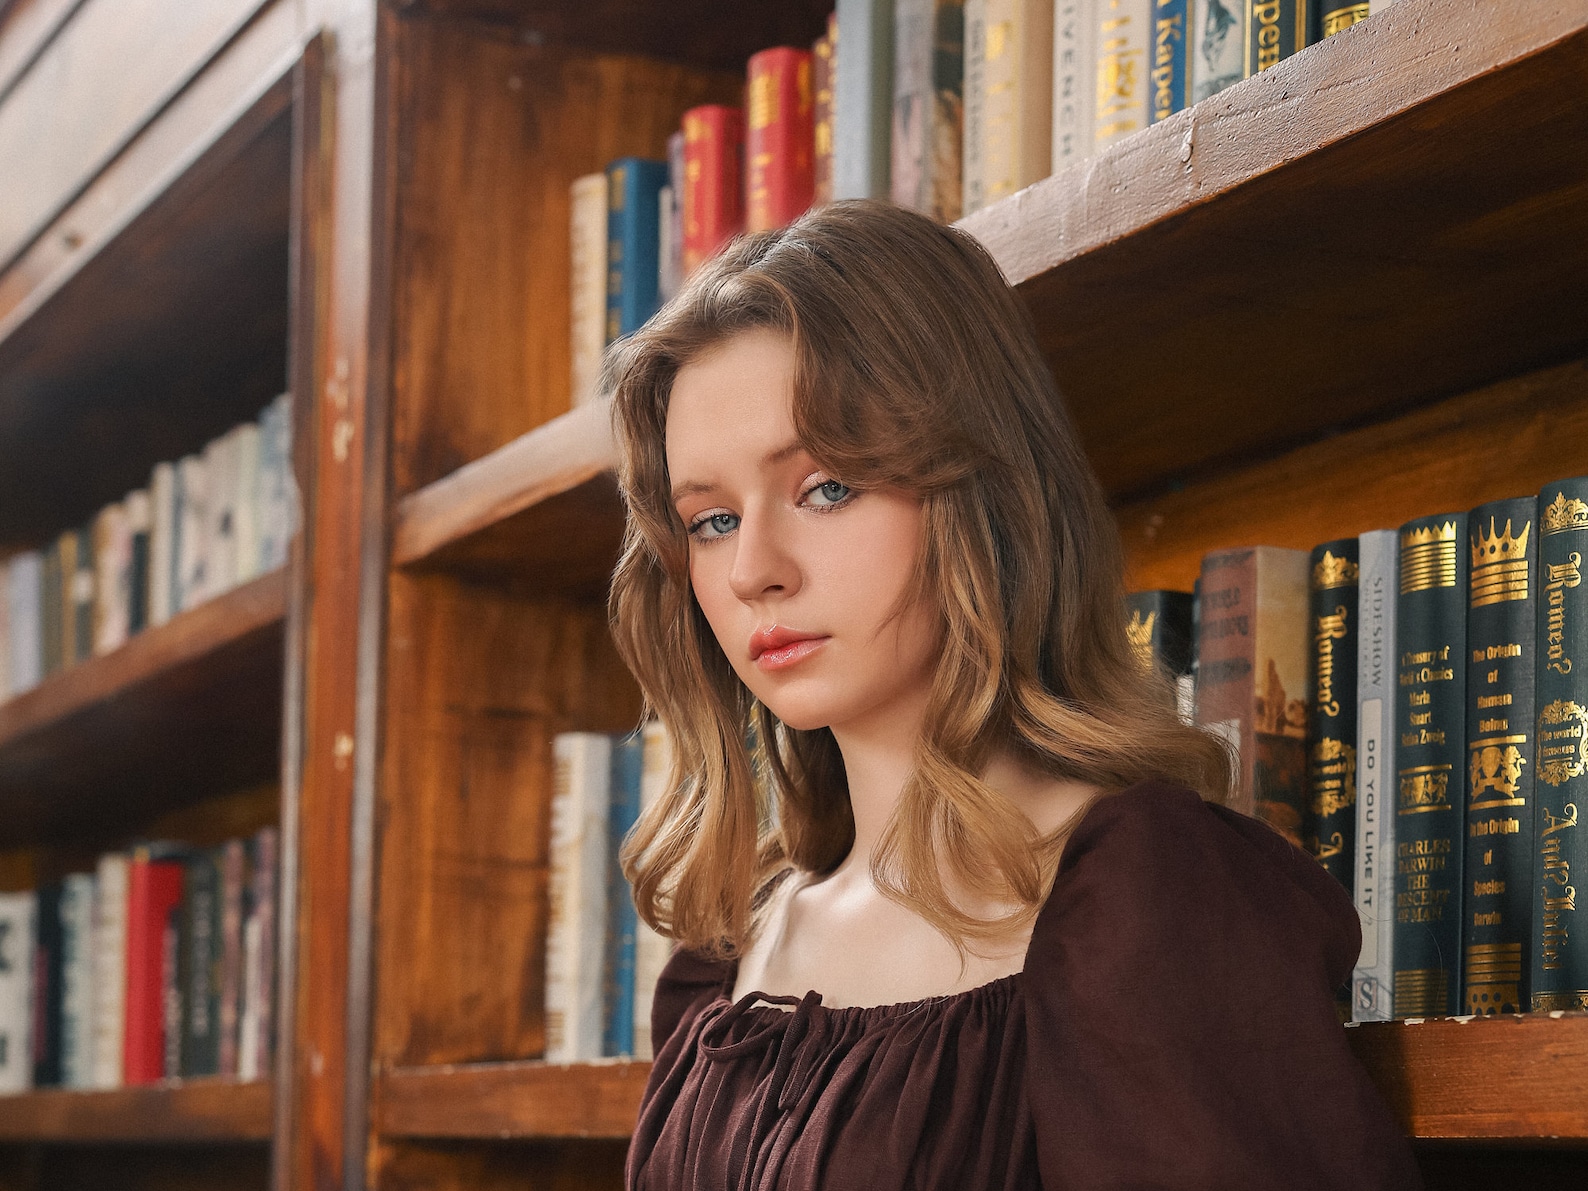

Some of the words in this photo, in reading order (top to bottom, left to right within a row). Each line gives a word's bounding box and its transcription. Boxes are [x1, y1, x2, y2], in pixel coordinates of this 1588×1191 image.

[1371, 577, 1383, 687] SIDESHOW
[1486, 643, 1521, 660] Origin
[1487, 669, 1498, 683] of
[1477, 693, 1513, 709] Human
[1553, 725, 1582, 740] world
[1366, 739, 1376, 770] DO
[1365, 778, 1375, 823] YOU
[1489, 817, 1520, 835] Origin
[1364, 831, 1374, 878] LIKE
[1397, 839, 1450, 857] CHARLES
[1397, 857, 1446, 874] DARWIN
[1483, 849, 1493, 865] of
[1407, 874, 1430, 890] THE
[1473, 880, 1506, 897] Species
[1363, 888, 1373, 908] IT
[1474, 911, 1502, 926] Darwin
